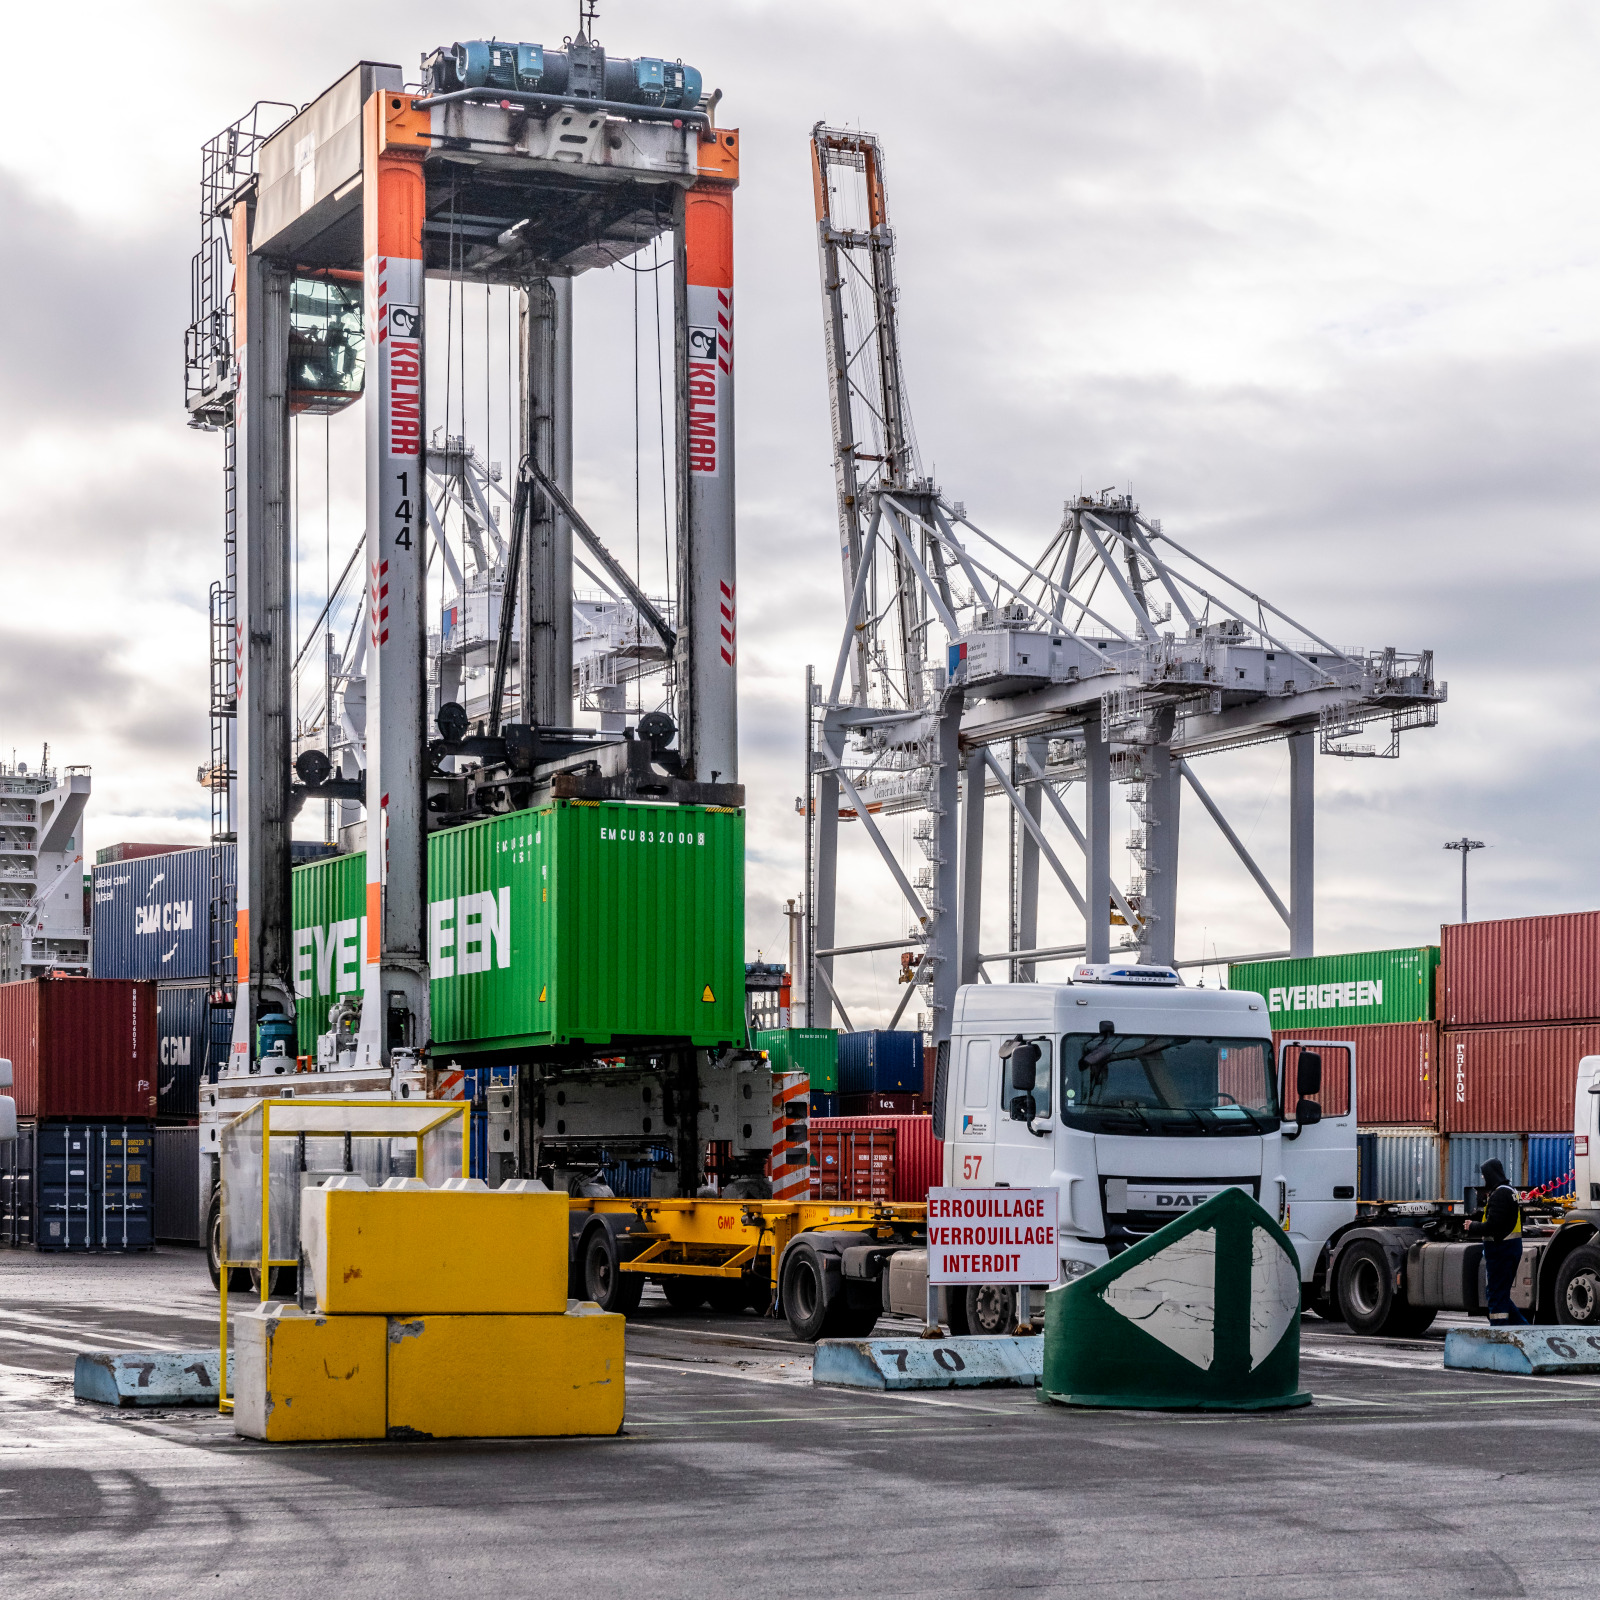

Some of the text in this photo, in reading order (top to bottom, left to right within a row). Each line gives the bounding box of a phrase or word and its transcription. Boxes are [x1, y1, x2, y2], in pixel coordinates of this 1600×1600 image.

[391, 341, 419, 455] KALMAR
[689, 362, 716, 472] KALMAR
[395, 472, 412, 551] 144
[135, 900, 193, 935] CMA CGM
[1269, 979, 1383, 1012] EVERGREEN
[161, 1036, 191, 1066] CGM
[1456, 1043, 1465, 1103] TRITON
[880, 1100, 895, 1109] tex
[963, 1155, 982, 1181] 57
[929, 1199, 1044, 1218] ERROUILLAGE
[1156, 1194, 1208, 1207] DAF
[717, 1215, 735, 1230] GMP
[929, 1226, 1054, 1246] VERROUILLAGE
[943, 1254, 1021, 1273] INTERDIT
[880, 1348, 966, 1373] 70
[123, 1362, 213, 1388] 71
